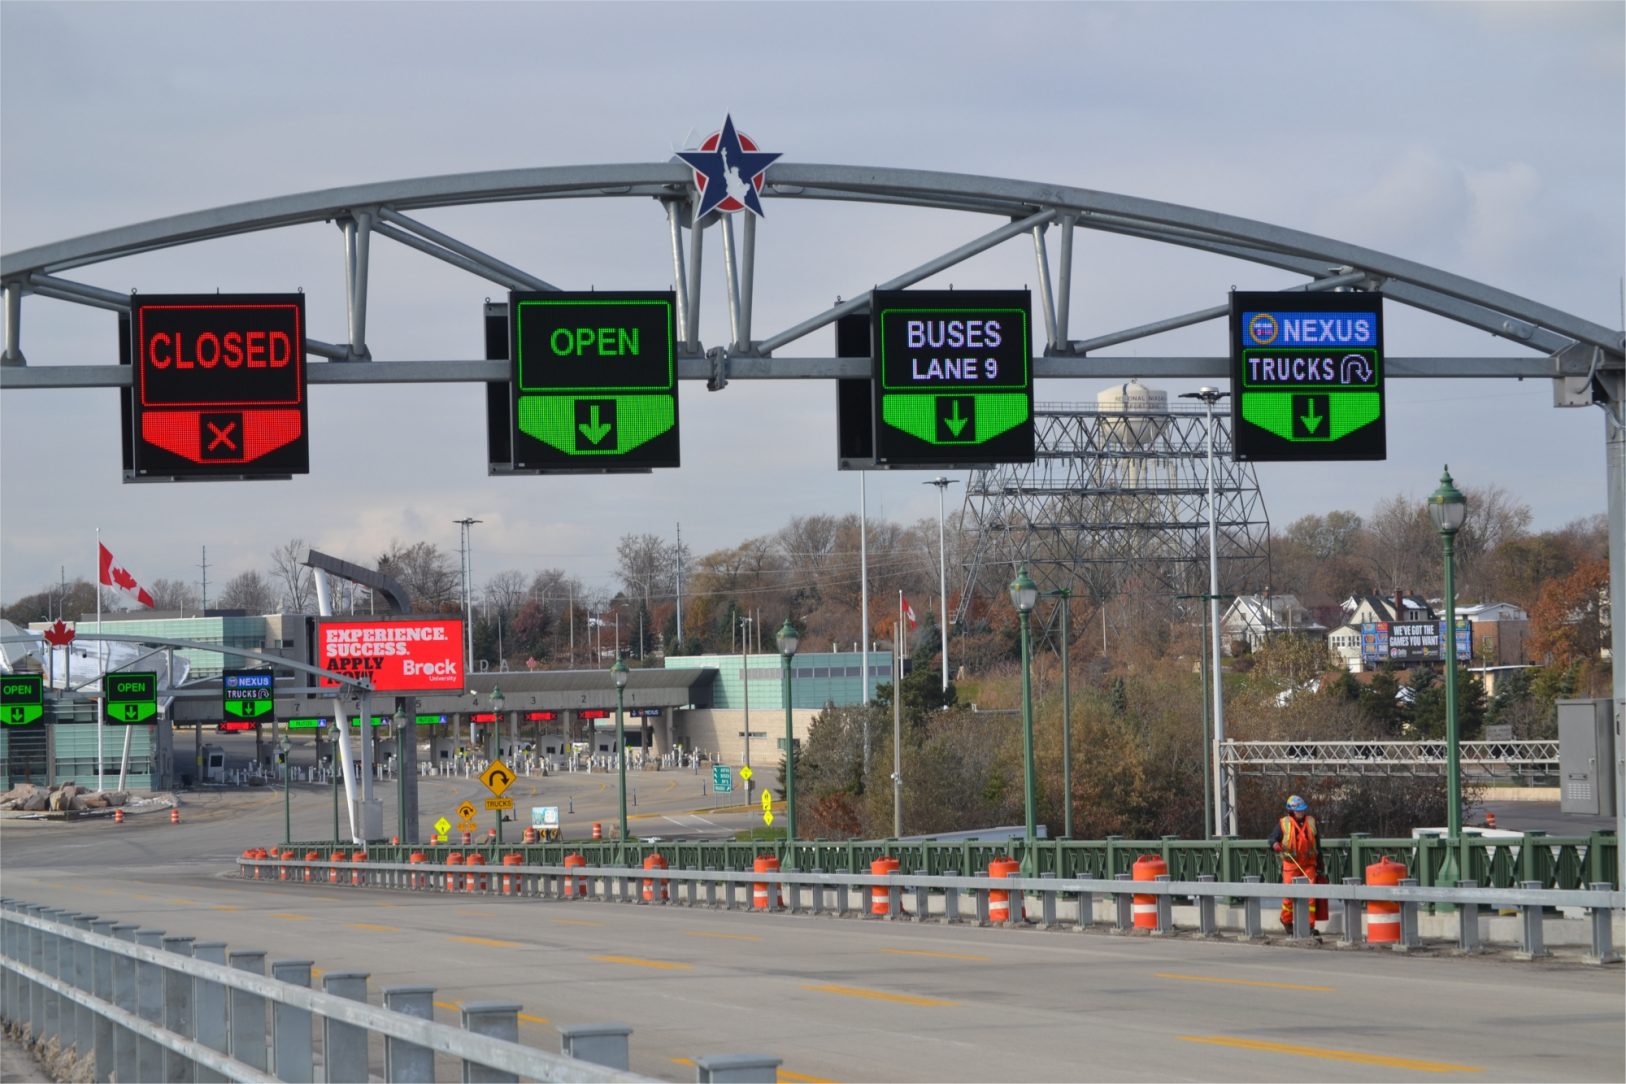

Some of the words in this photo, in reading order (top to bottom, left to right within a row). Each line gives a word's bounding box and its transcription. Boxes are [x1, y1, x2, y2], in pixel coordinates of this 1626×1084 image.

[907, 319, 1002, 349] BUSES
[1283, 318, 1371, 343] NEXUS
[550, 327, 640, 357] OPEN
[149, 331, 291, 369] CLOSED
[912, 358, 980, 380] LANE
[986, 358, 998, 379] 9
[1249, 357, 1335, 381] TRUCKS
[326, 627, 448, 643] EXPERIENCE.
[1393, 625, 1411, 636] WE'VE
[1411, 625, 1423, 635] GOT
[1423, 624, 1434, 634] THE
[1389, 636, 1409, 647] GAMES
[1410, 636, 1422, 646] YOU
[1422, 635, 1439, 645] WANT
[326, 642, 410, 657] SUCCESS.
[326, 657, 385, 671] APPLY
[403, 659, 457, 676] Brock
[117, 682, 146, 693] OPEN
[239, 677, 269, 686] NEXUS
[3, 685, 32, 695] OPEN
[228, 690, 257, 698] TRUCKS
[473, 699, 479, 707] 4
[531, 696, 536, 704] 3
[581, 695, 587, 703] 2
[294, 704, 300, 712] 7
[486, 799, 512, 808] TRUCKS
